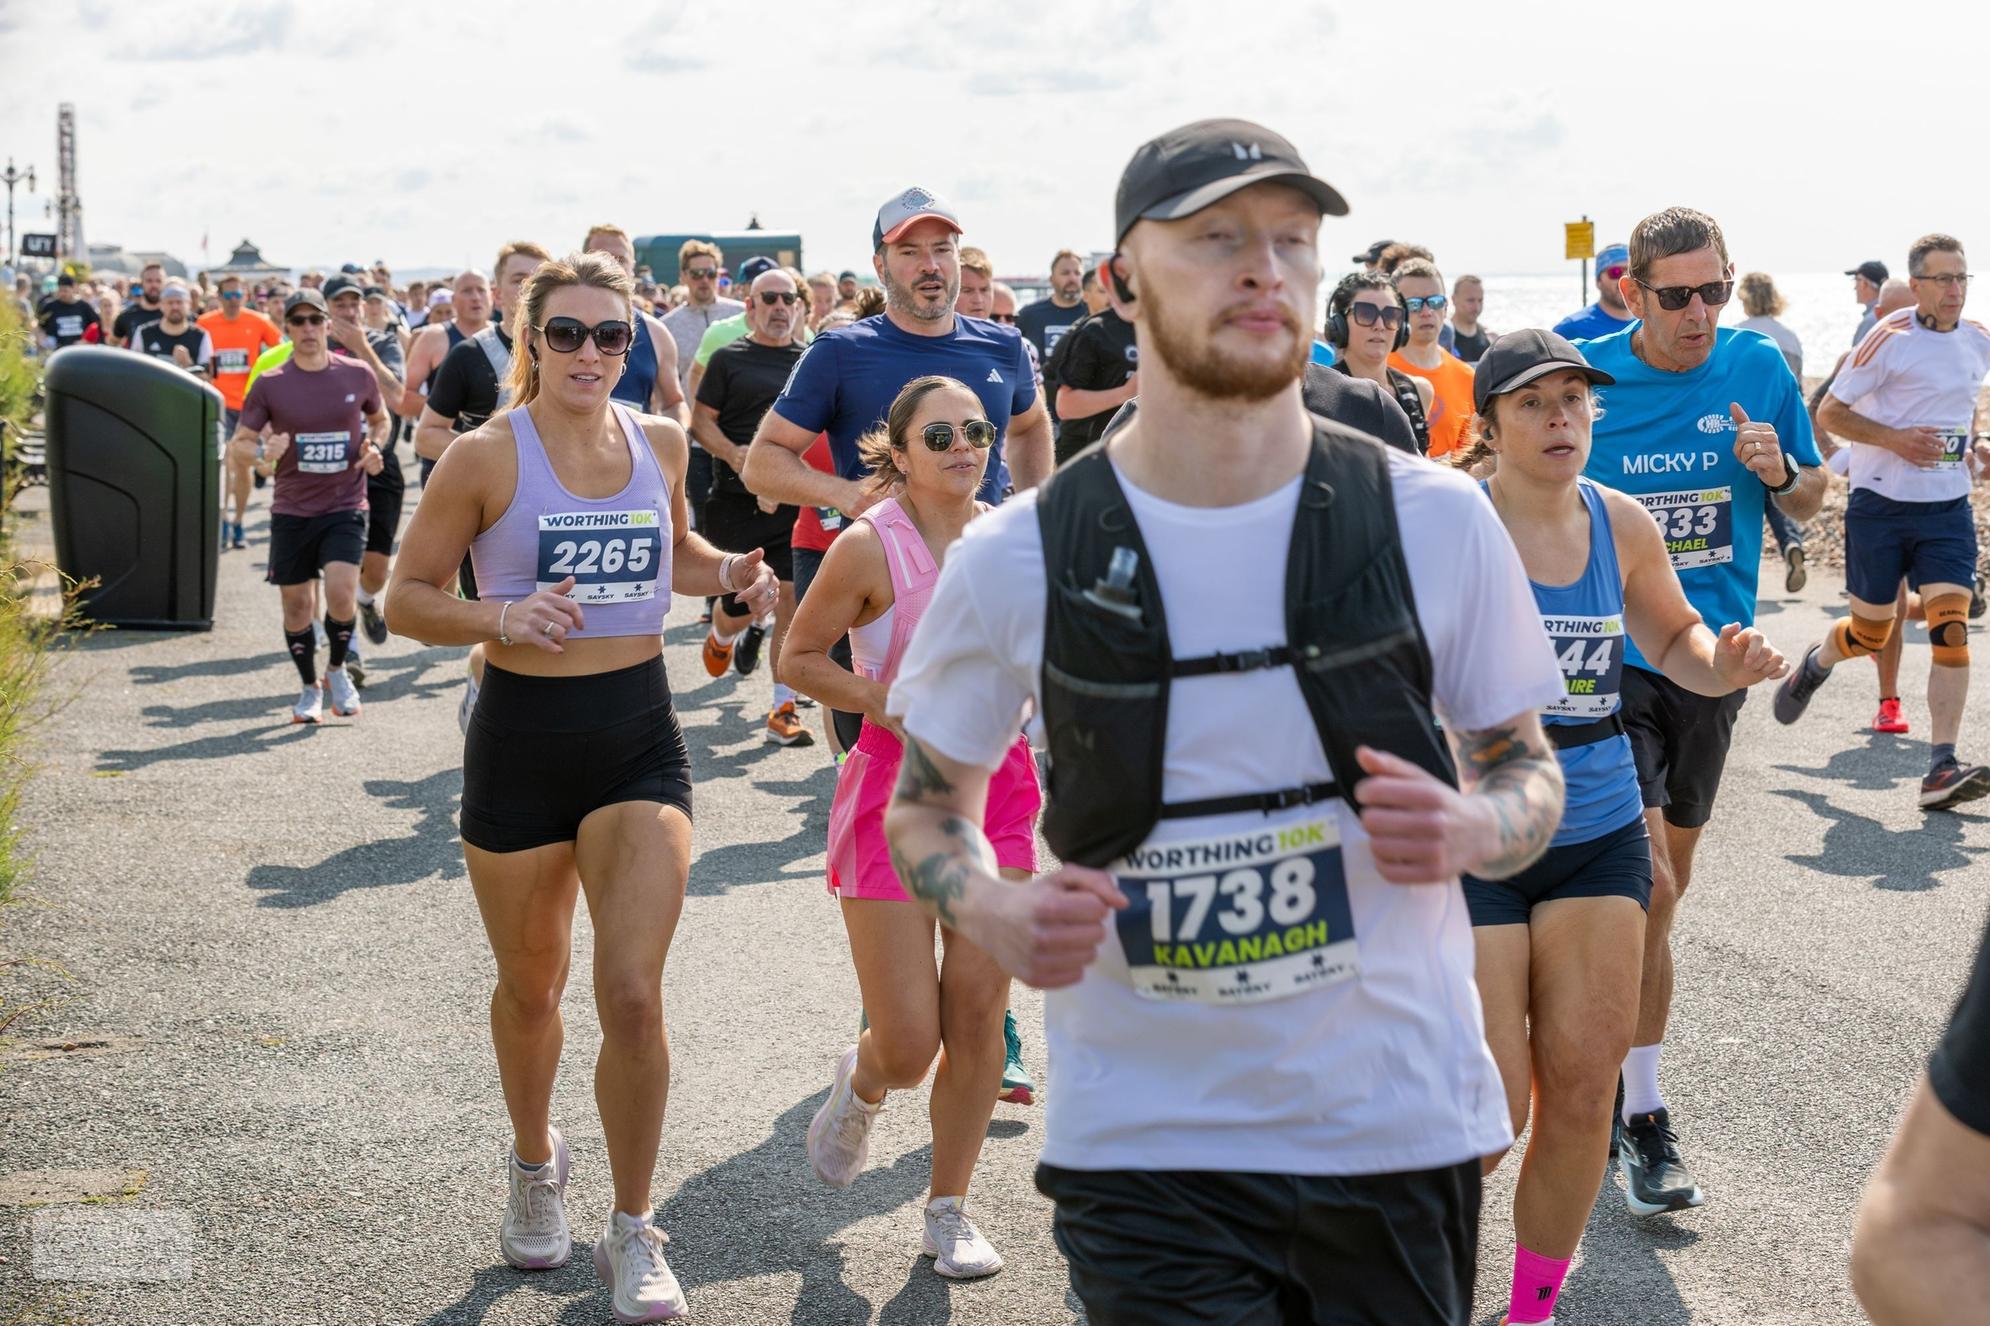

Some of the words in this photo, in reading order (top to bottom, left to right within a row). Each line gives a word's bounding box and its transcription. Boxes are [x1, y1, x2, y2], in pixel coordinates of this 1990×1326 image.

[303, 443, 346, 460] 2315
[1623, 452, 1696, 474] MICKY
[1703, 452, 1719, 471] P
[544, 514, 629, 527] WORTHING
[630, 513, 653, 524] 10K
[548, 538, 653, 574] 2265
[1551, 639, 1613, 676] 44
[1125, 835, 1274, 870] WORTHING
[1278, 821, 1325, 849] 10K
[1146, 856, 1317, 942] 1738
[1153, 920, 1328, 969] KAVANAGH
